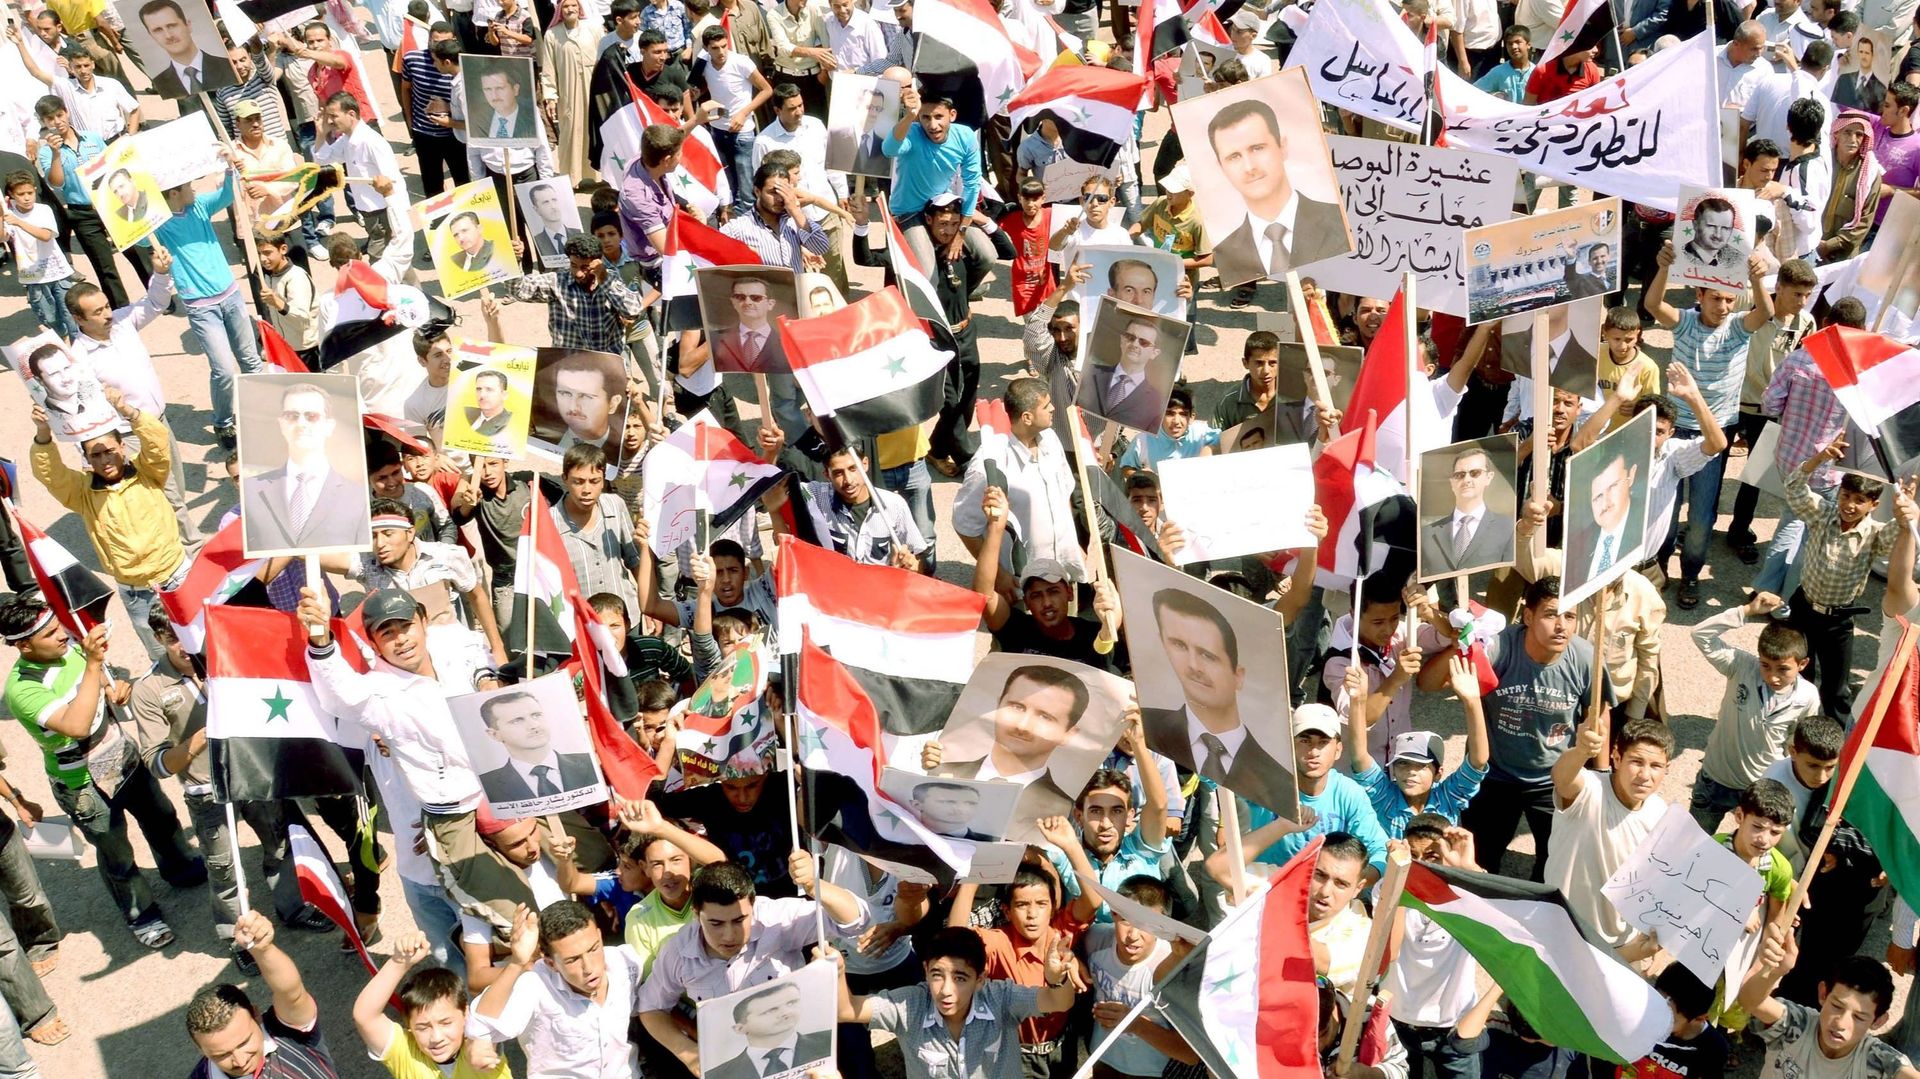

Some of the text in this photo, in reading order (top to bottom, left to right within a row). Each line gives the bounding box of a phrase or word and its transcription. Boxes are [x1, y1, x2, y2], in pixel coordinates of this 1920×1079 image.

[1332, 144, 1492, 187] عشيرة البوصا
[1495, 684, 1528, 697] ENTRY
[1533, 684, 1562, 698] LEVEL
[1507, 695, 1536, 705] TOTAL
[546, 796, 565, 806] بشار
[567, 787, 597, 801] الدكتور
